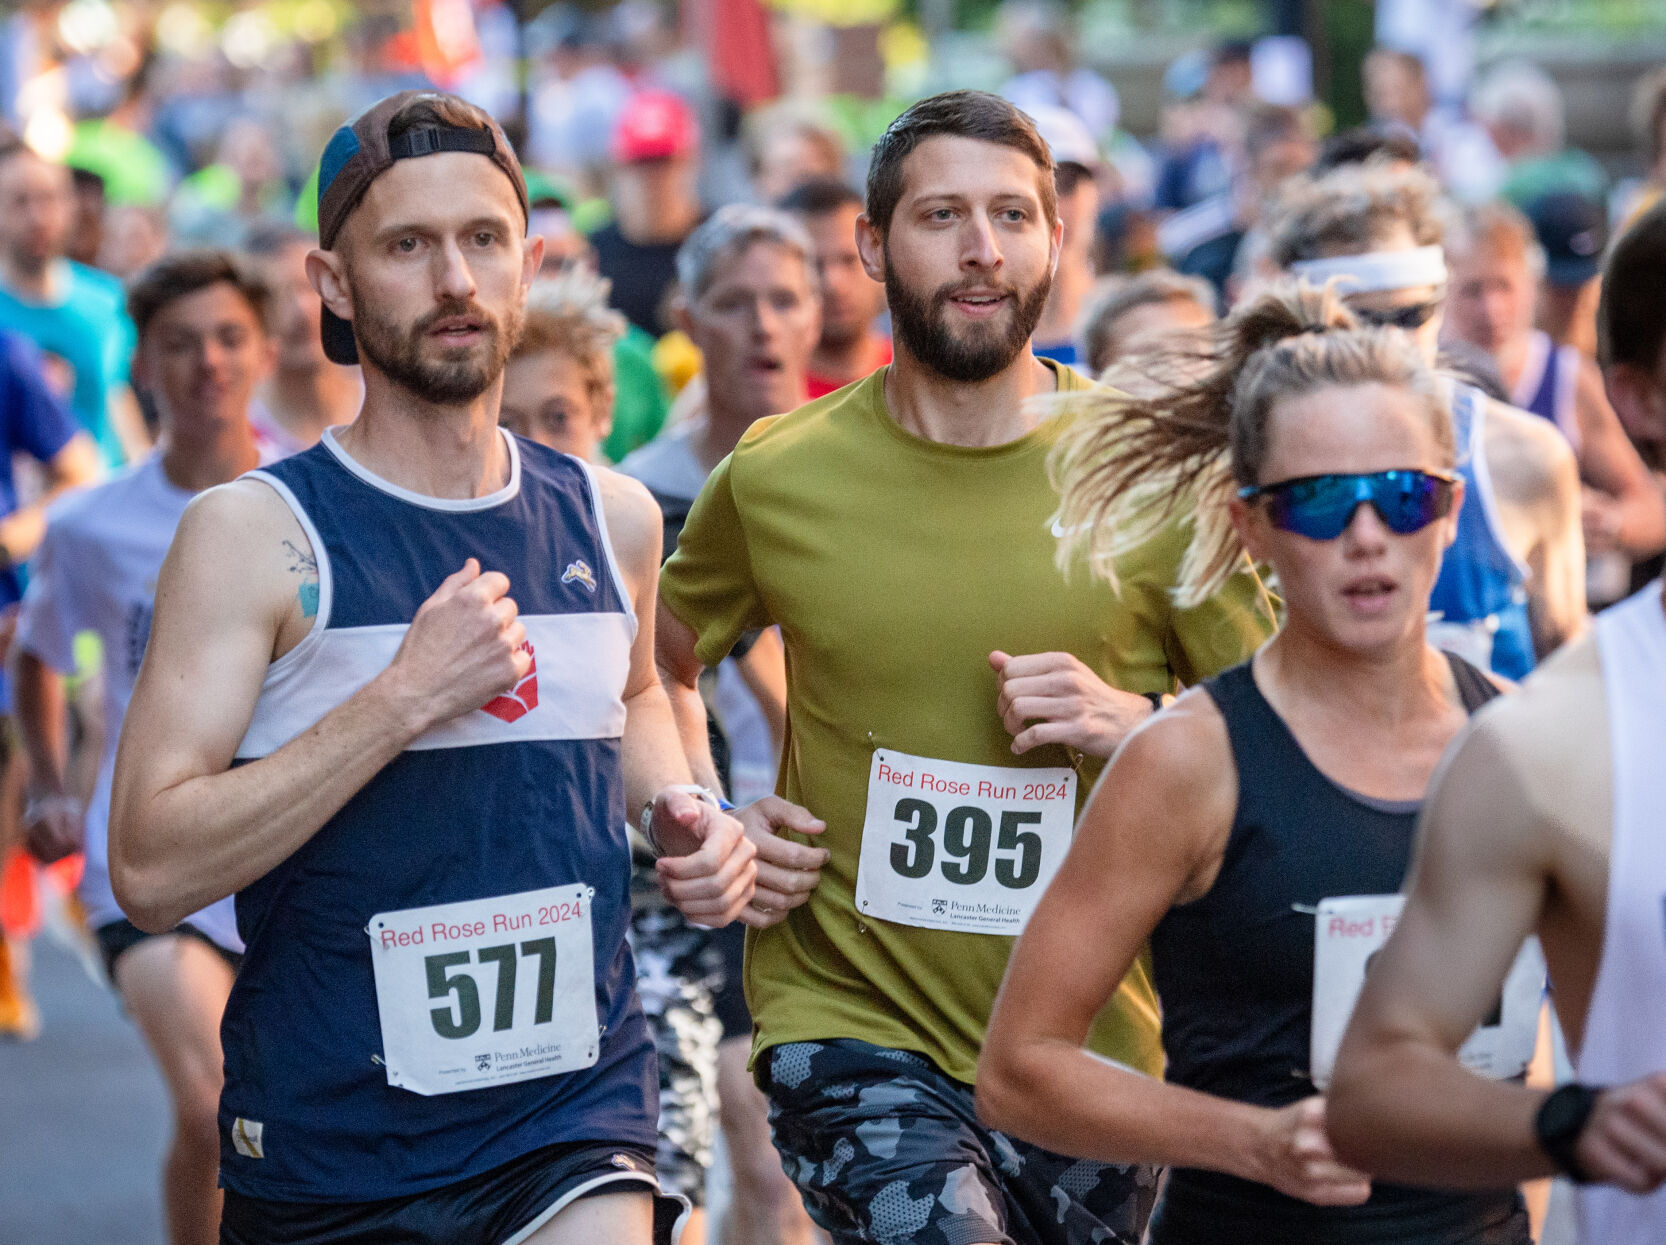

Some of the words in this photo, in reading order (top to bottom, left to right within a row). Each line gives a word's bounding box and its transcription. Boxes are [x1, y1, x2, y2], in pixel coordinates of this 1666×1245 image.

[878, 764, 914, 787] Red
[920, 773, 970, 796] Rose
[977, 781, 1017, 800] Run
[1023, 783, 1067, 801] 2024
[889, 797, 1043, 890] 395
[950, 913, 978, 921] Lancaster
[951, 901, 975, 912] Penn
[976, 903, 1021, 915] Medicine
[381, 927, 424, 948] Red
[431, 921, 485, 941] Rose
[493, 912, 532, 933] Run
[538, 902, 582, 926] 2024
[1328, 917, 1374, 937] Red
[425, 936, 557, 1040] 577
[494, 1051, 519, 1063] Penn
[520, 1044, 561, 1057] Medicine
[496, 1061, 522, 1072] Lancaster
